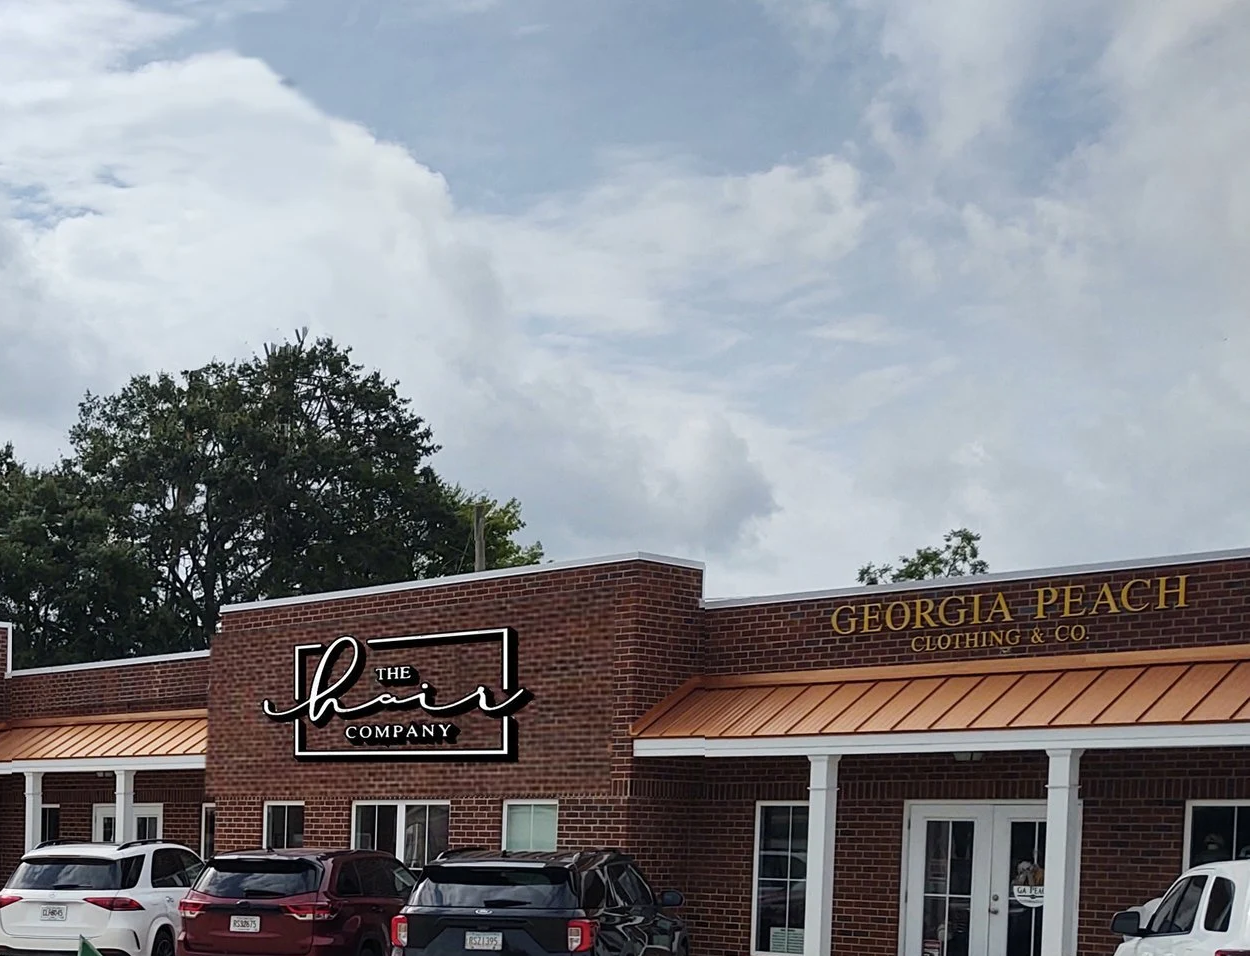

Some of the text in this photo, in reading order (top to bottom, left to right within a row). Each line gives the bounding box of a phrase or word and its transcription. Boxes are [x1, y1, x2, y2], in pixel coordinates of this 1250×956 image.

[830, 573, 1191, 636] GEORGIA PEACH
[911, 623, 1091, 653] CLOTHING & CO.
[263, 635, 525, 722] hair
[375, 666, 412, 681] THE
[345, 723, 452, 740] COMPANY
